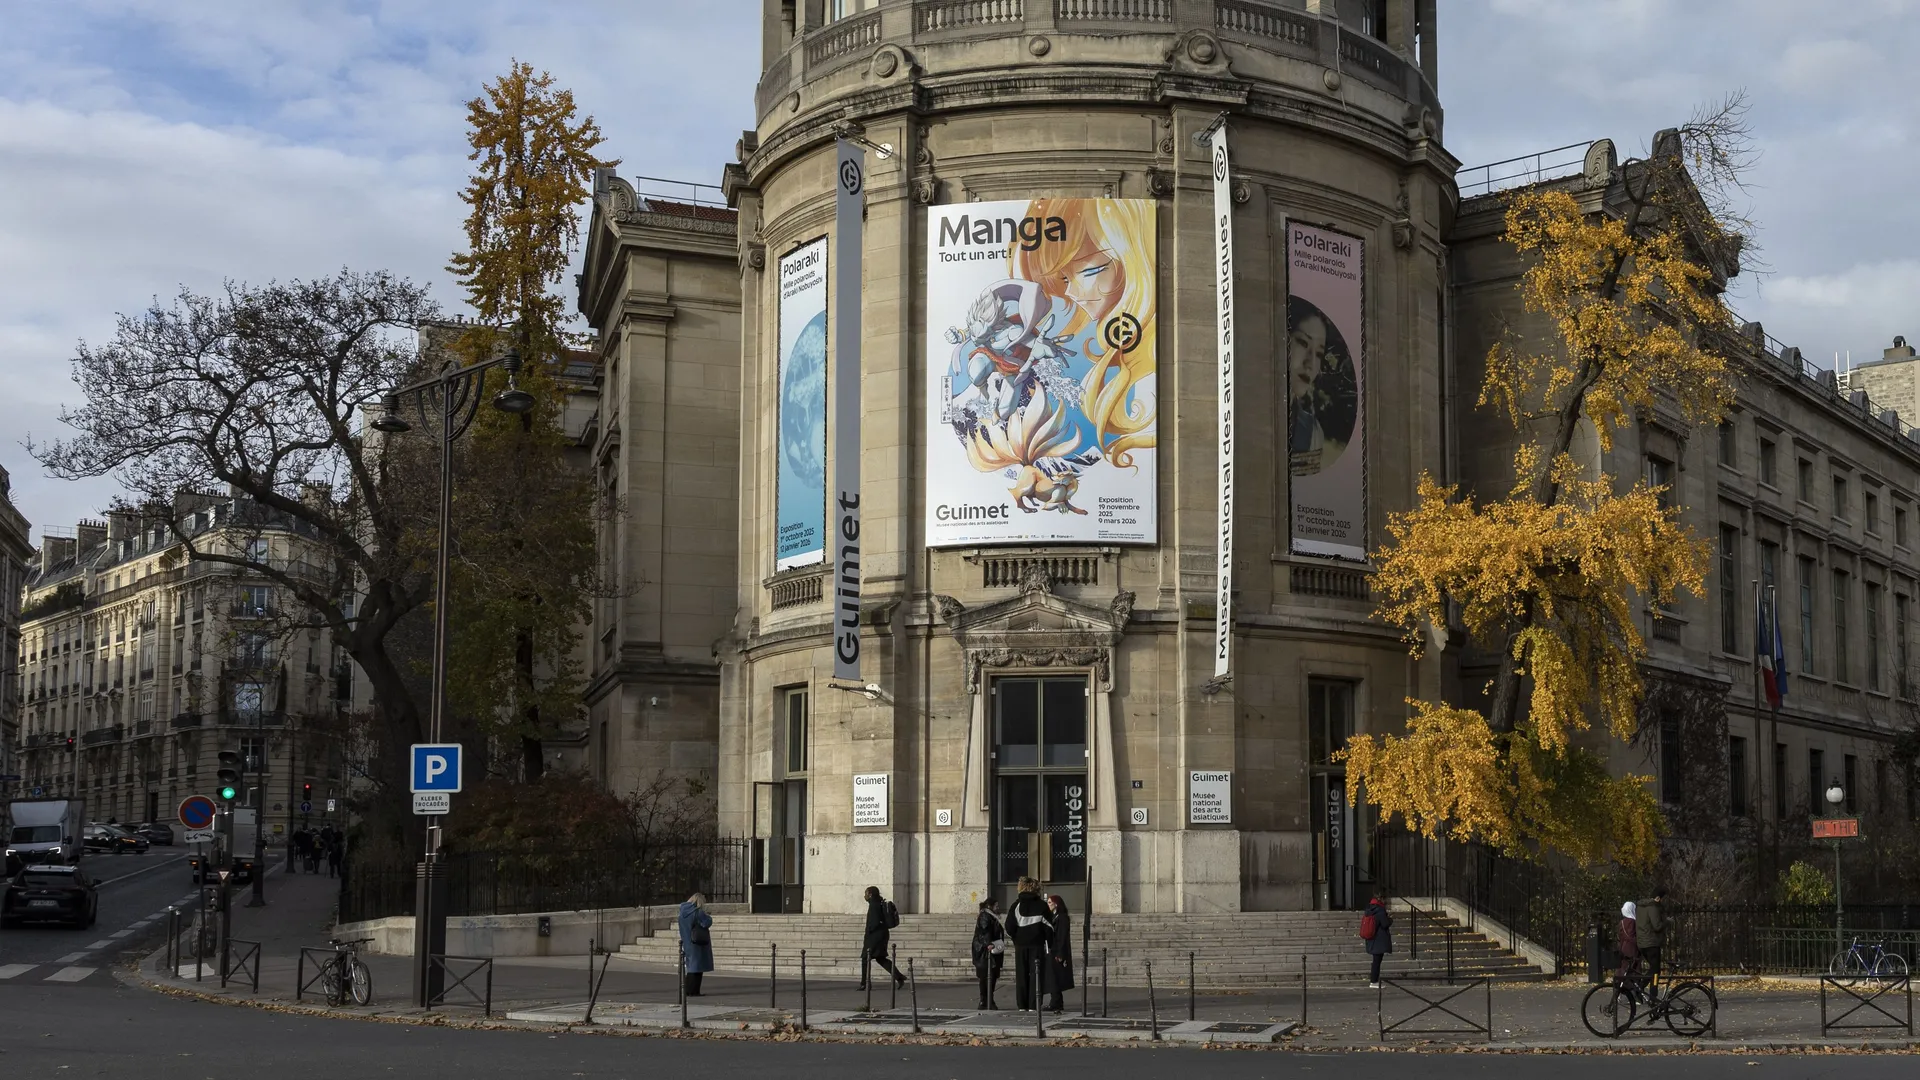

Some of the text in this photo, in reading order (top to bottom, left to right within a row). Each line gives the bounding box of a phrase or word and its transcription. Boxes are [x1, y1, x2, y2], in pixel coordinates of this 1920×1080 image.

[938, 214, 1066, 251] Manga
[1294, 230, 1351, 257] Polaraki
[784, 248, 819, 278] Polaraki
[939, 251, 966, 263] Tout
[969, 252, 984, 260] un
[1294, 250, 1346, 268] Mille polaroids
[1294, 260, 1356, 280] d'Araki Nobuyoshi
[784, 270, 816, 290] Mille polaroids
[799, 275, 823, 292] Nobuyoshi
[1221, 214, 1230, 346] asiatiques
[936, 503, 1009, 520] Guimet
[1222, 462, 1230, 568] national
[1297, 504, 1334, 516] Exposition
[780, 521, 804, 534] Exposition
[1306, 516, 1334, 526] octobre
[1336, 520, 1351, 529] 2025
[1306, 526, 1330, 536] janvier
[1331, 530, 1347, 538] 2026
[785, 531, 804, 541] octobre
[804, 528, 815, 538] 2025
[785, 541, 800, 552] janvier
[800, 538, 811, 548] 2026
[838, 492, 860, 664] Guimet
[1219, 576, 1229, 659] Musée
[426, 755, 447, 783] P
[1192, 773, 1228, 781] Guimet
[856, 777, 886, 785] Guimet
[1066, 786, 1082, 856] entrée
[1329, 789, 1339, 848] sortie
